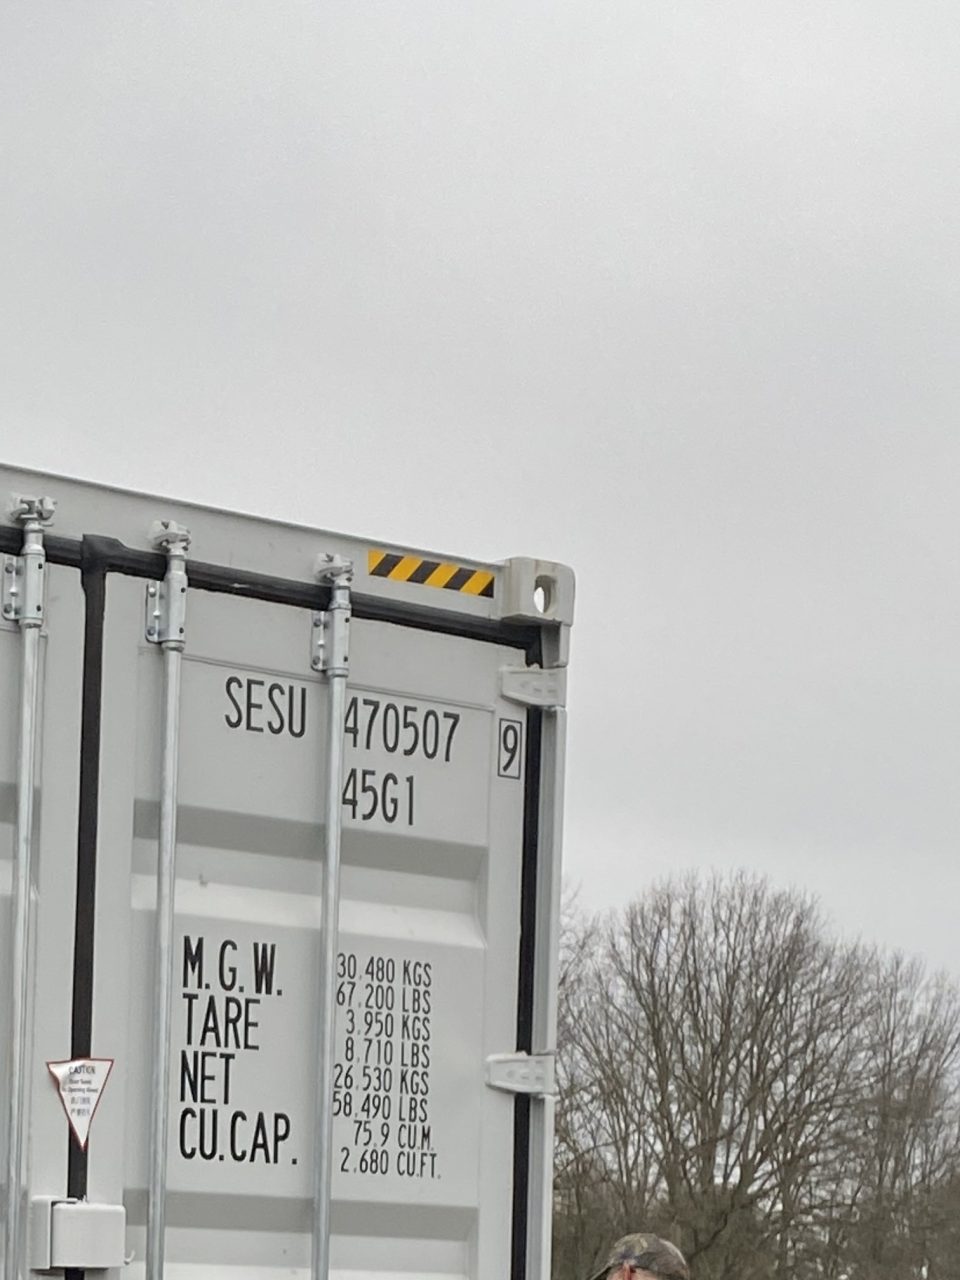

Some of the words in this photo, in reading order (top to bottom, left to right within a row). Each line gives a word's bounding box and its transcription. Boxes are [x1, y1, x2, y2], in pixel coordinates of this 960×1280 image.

[224, 676, 307, 738] SESU
[343, 696, 461, 762] 470507
[501, 723, 520, 773] 9
[342, 768, 415, 826] 45G1
[403, 960, 432, 988] KGS
[402, 987, 431, 1014] LBS
[182, 993, 261, 1050] TARE
[401, 1014, 430, 1042] KGS
[400, 1041, 429, 1069] LBS
[180, 1050, 236, 1105] NET
[400, 1069, 429, 1096] KGS
[399, 1096, 428, 1123] LBS
[353, 1120, 390, 1147] 75.9
